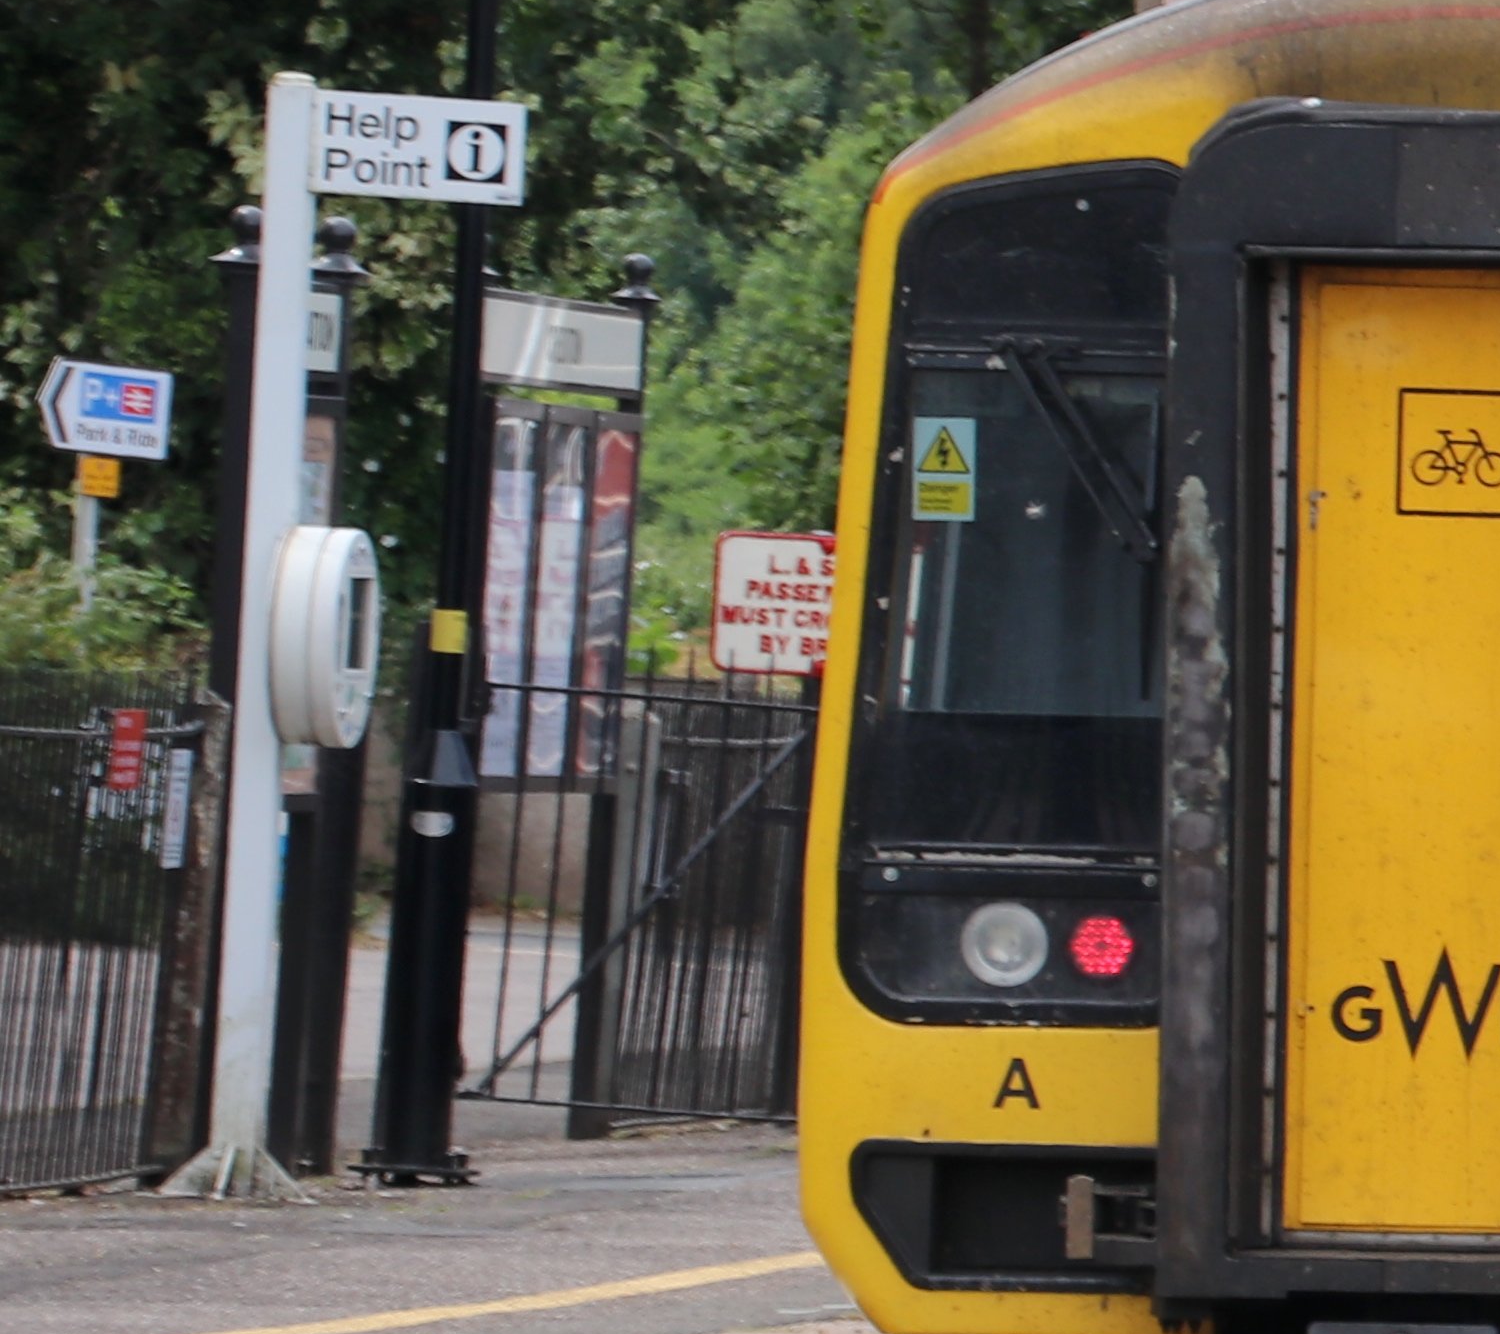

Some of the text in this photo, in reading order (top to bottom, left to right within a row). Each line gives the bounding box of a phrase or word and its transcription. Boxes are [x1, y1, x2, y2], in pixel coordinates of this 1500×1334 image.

[326, 102, 419, 149] Help
[323, 148, 430, 188] Point
[76, 423, 107, 443] Park
[125, 428, 160, 450] Ride
[720, 604, 787, 629] MUST
[759, 634, 790, 655] BY
[992, 1057, 1041, 1110] A
